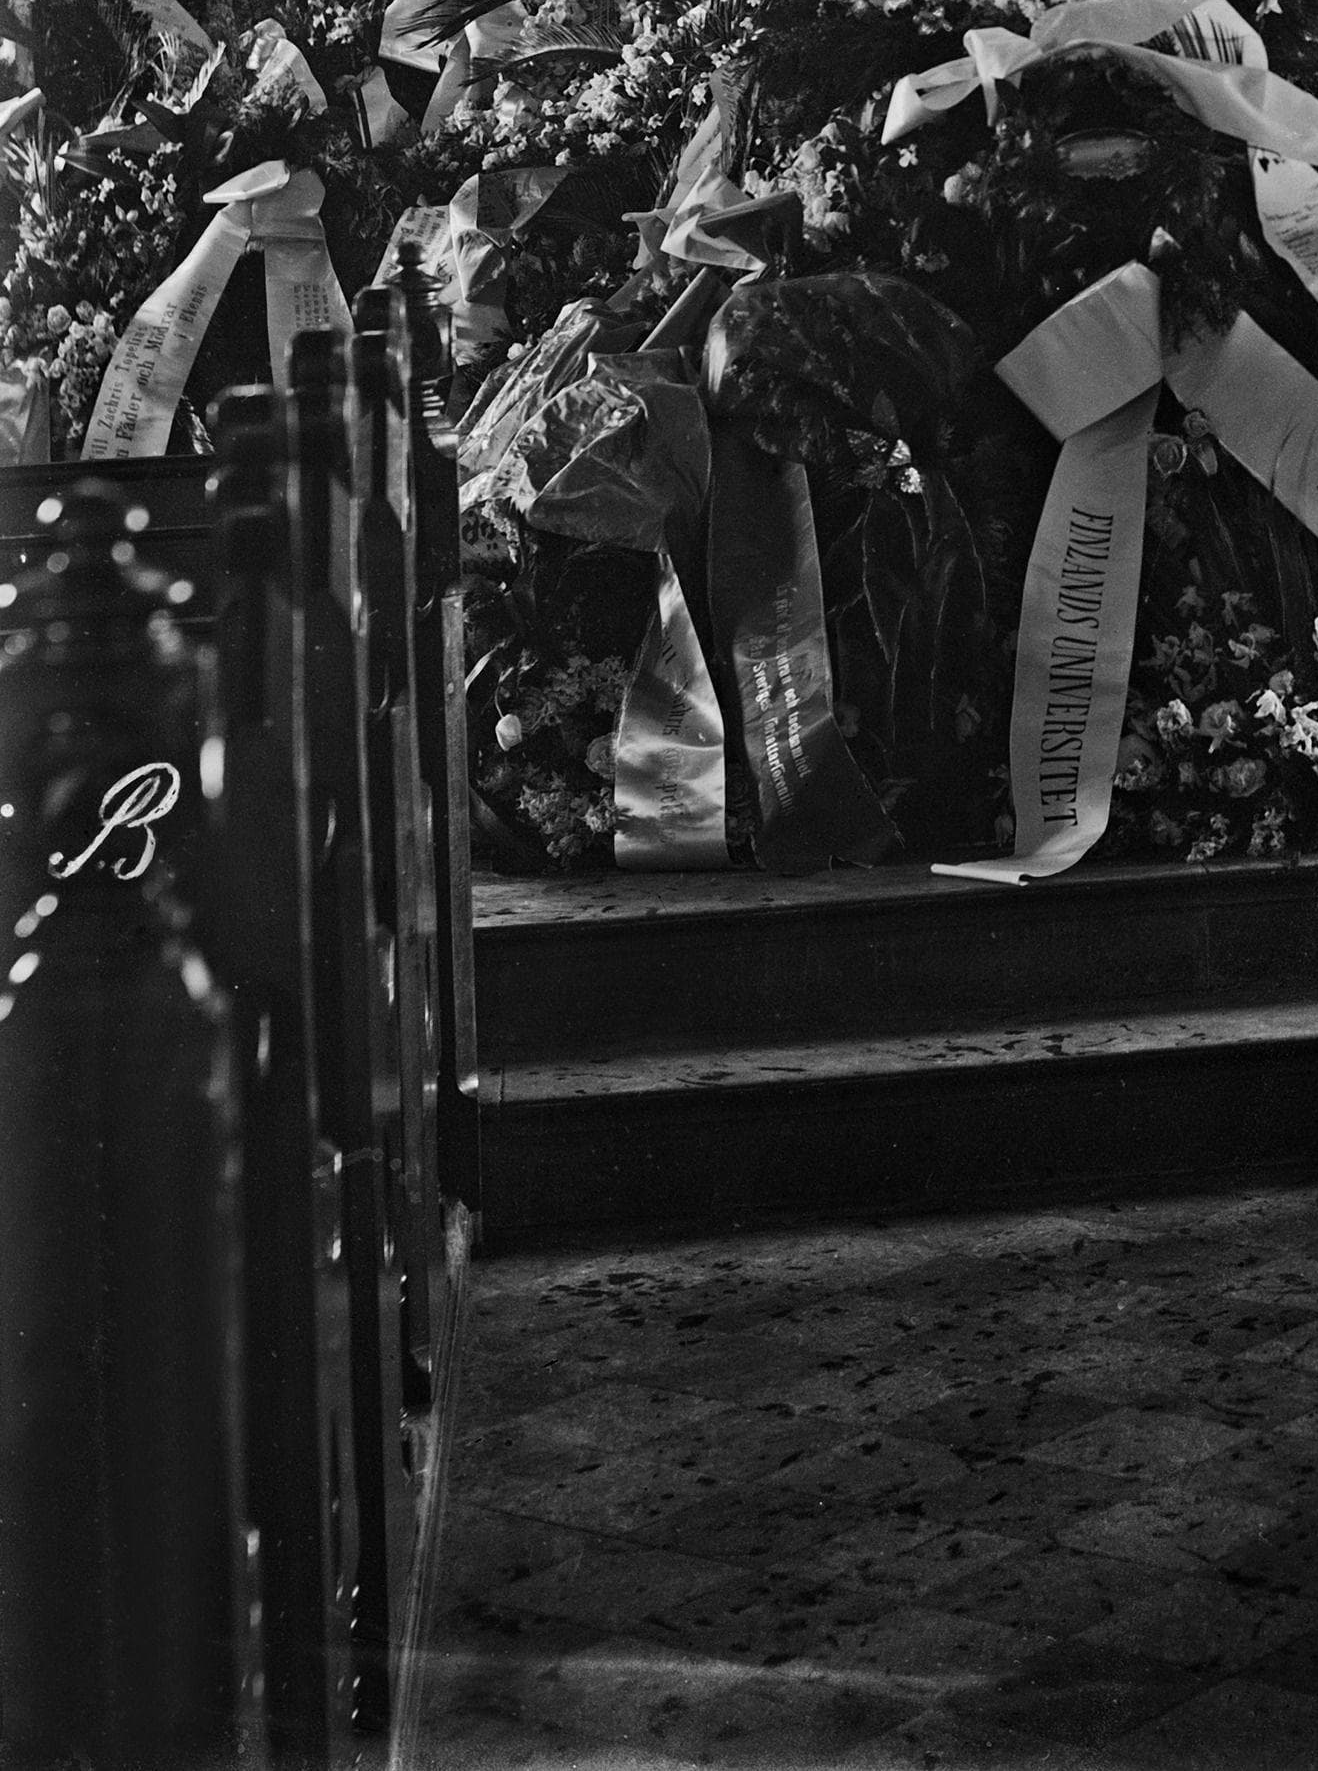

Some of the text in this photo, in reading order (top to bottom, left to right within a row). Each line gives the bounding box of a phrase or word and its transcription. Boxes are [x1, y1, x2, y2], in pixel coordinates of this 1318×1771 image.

[143, 301, 178, 354] Mödrar
[178, 284, 208, 325] Ekenäs
[97, 380, 124, 430] Zachris
[114, 325, 149, 374] Topelius
[136, 360, 155, 387] och
[115, 392, 143, 442] Fäder
[752, 660, 773, 713] Sveriges
[1039, 506, 1114, 827] FINLANDS UNIVERSITET
